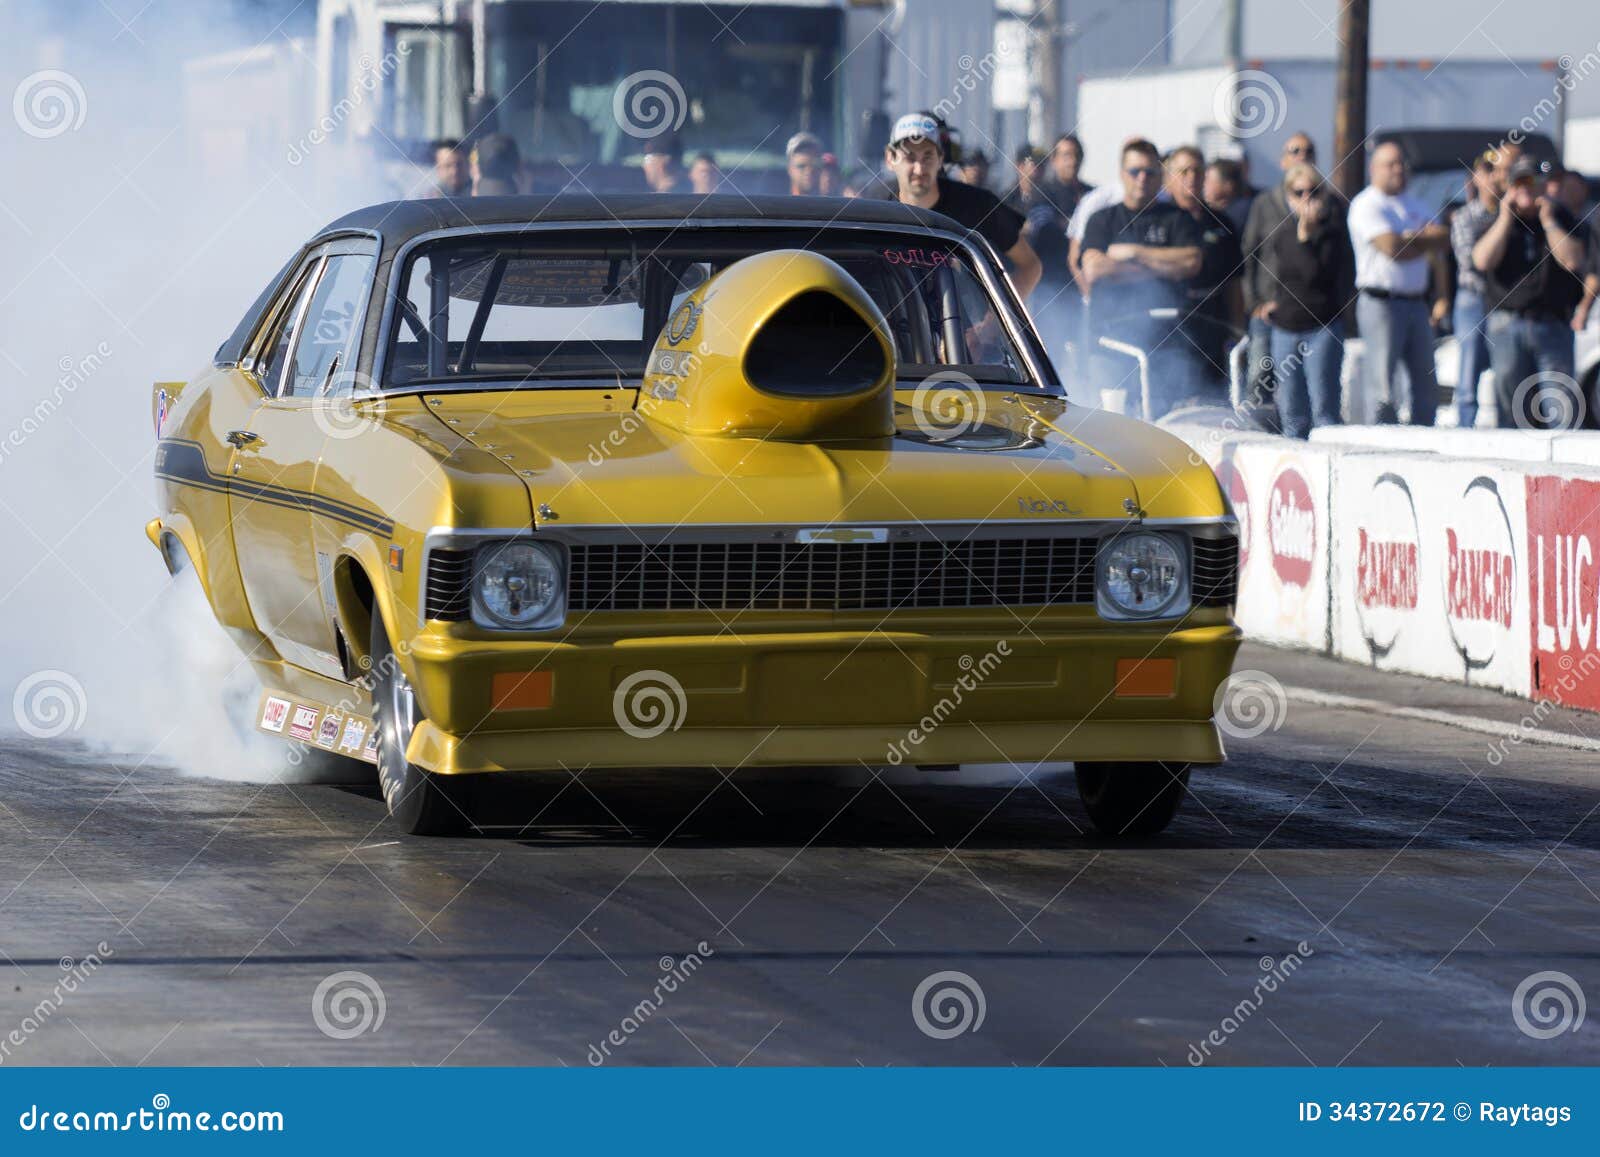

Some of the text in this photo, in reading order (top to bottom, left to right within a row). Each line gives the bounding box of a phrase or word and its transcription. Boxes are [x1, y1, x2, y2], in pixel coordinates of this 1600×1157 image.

[1357, 527, 1418, 609] RANCHO
[1446, 527, 1513, 630] RANCHO
[1537, 534, 1600, 652] LUC
